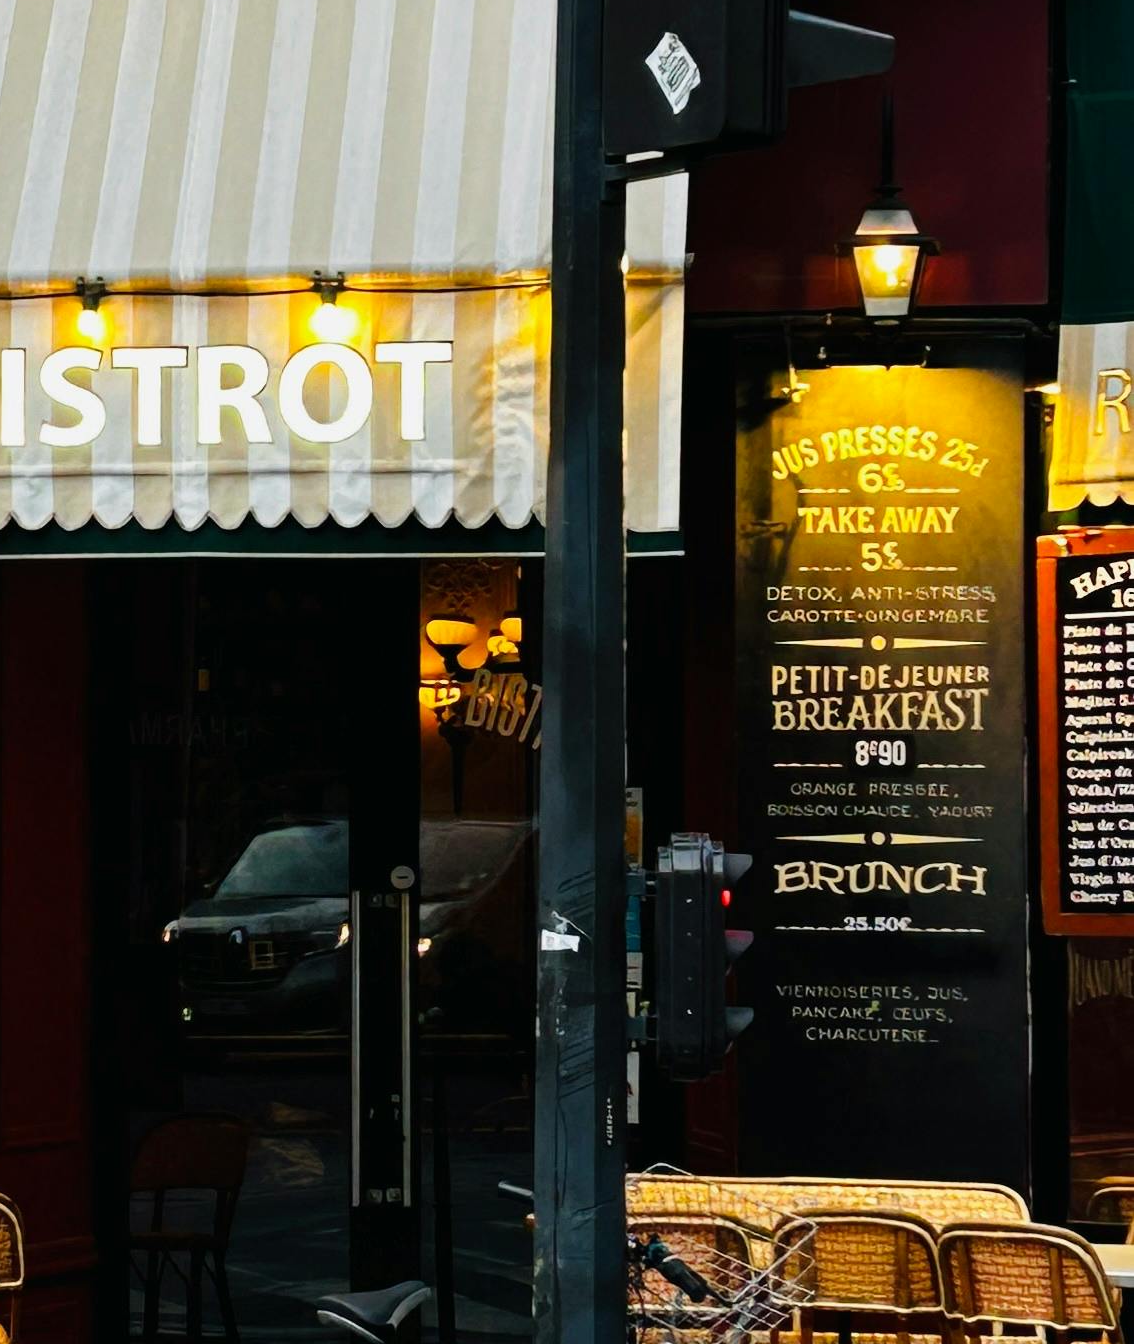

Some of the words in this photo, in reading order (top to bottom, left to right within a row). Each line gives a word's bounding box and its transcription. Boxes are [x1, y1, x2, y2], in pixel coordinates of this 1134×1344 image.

[772, 437, 820, 481] JUS
[797, 506, 876, 534] TAKE
[880, 506, 960, 534] AWAY
[771, 688, 990, 731] BREAKFAST
[790, 782, 858, 796] ORANGE
[767, 804, 838, 817] BOISSON
[773, 860, 988, 896] BRUNCH
